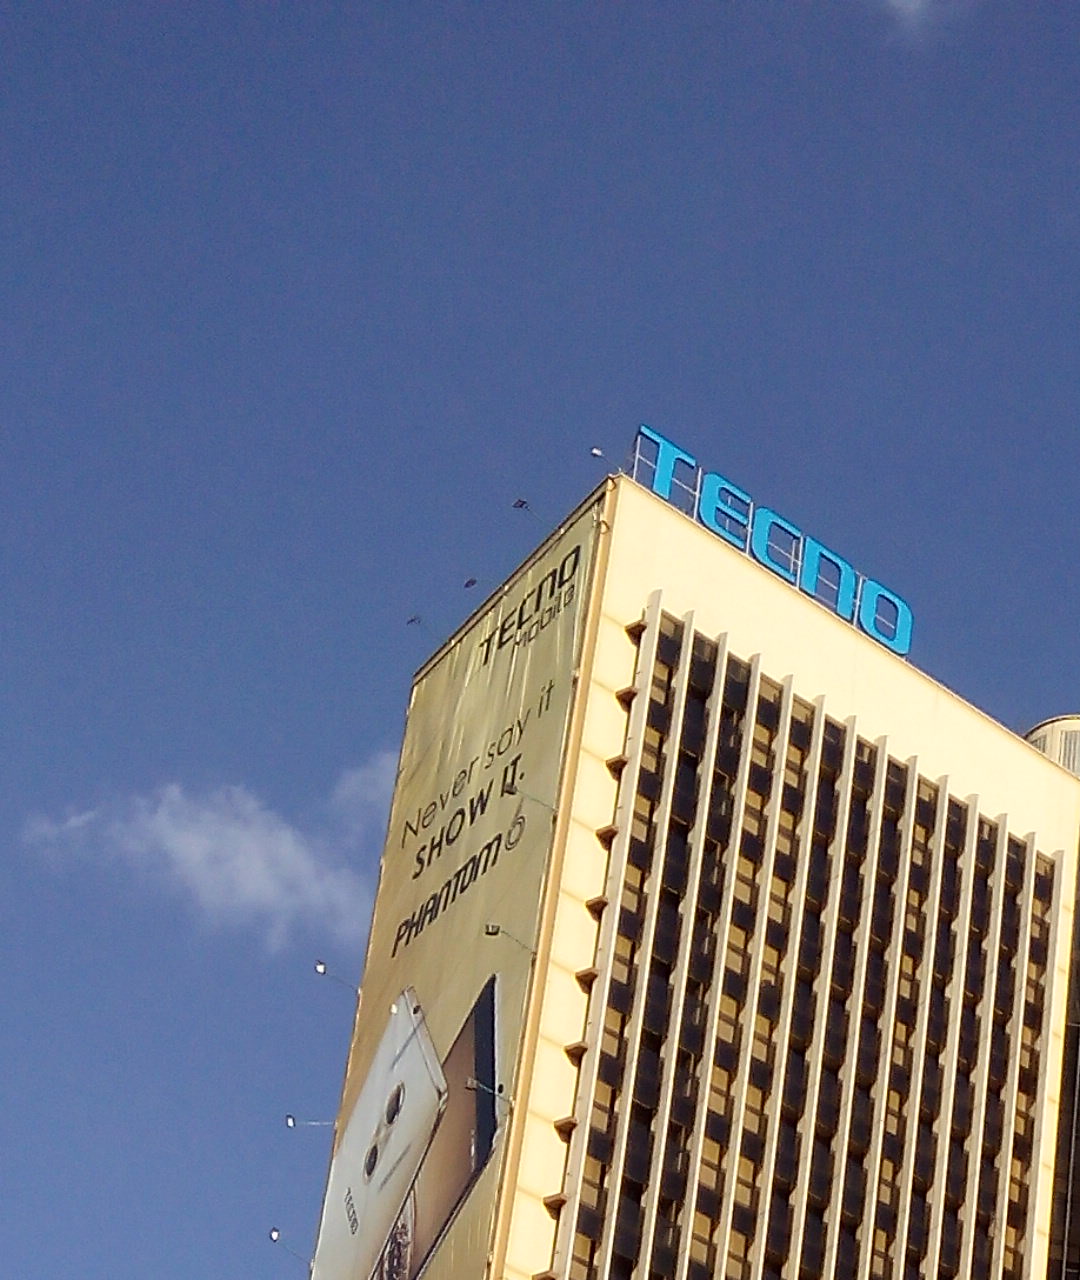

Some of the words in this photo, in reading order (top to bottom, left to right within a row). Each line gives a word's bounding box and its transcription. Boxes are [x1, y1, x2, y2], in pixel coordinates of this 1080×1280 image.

[639, 425, 914, 656] TECNO
[479, 545, 581, 666] TECNO
[401, 756, 480, 849] Never
[484, 709, 531, 770] say
[537, 679, 556, 719] it
[412, 777, 495, 881] SHOW
[390, 833, 503, 958] PHANTOM
